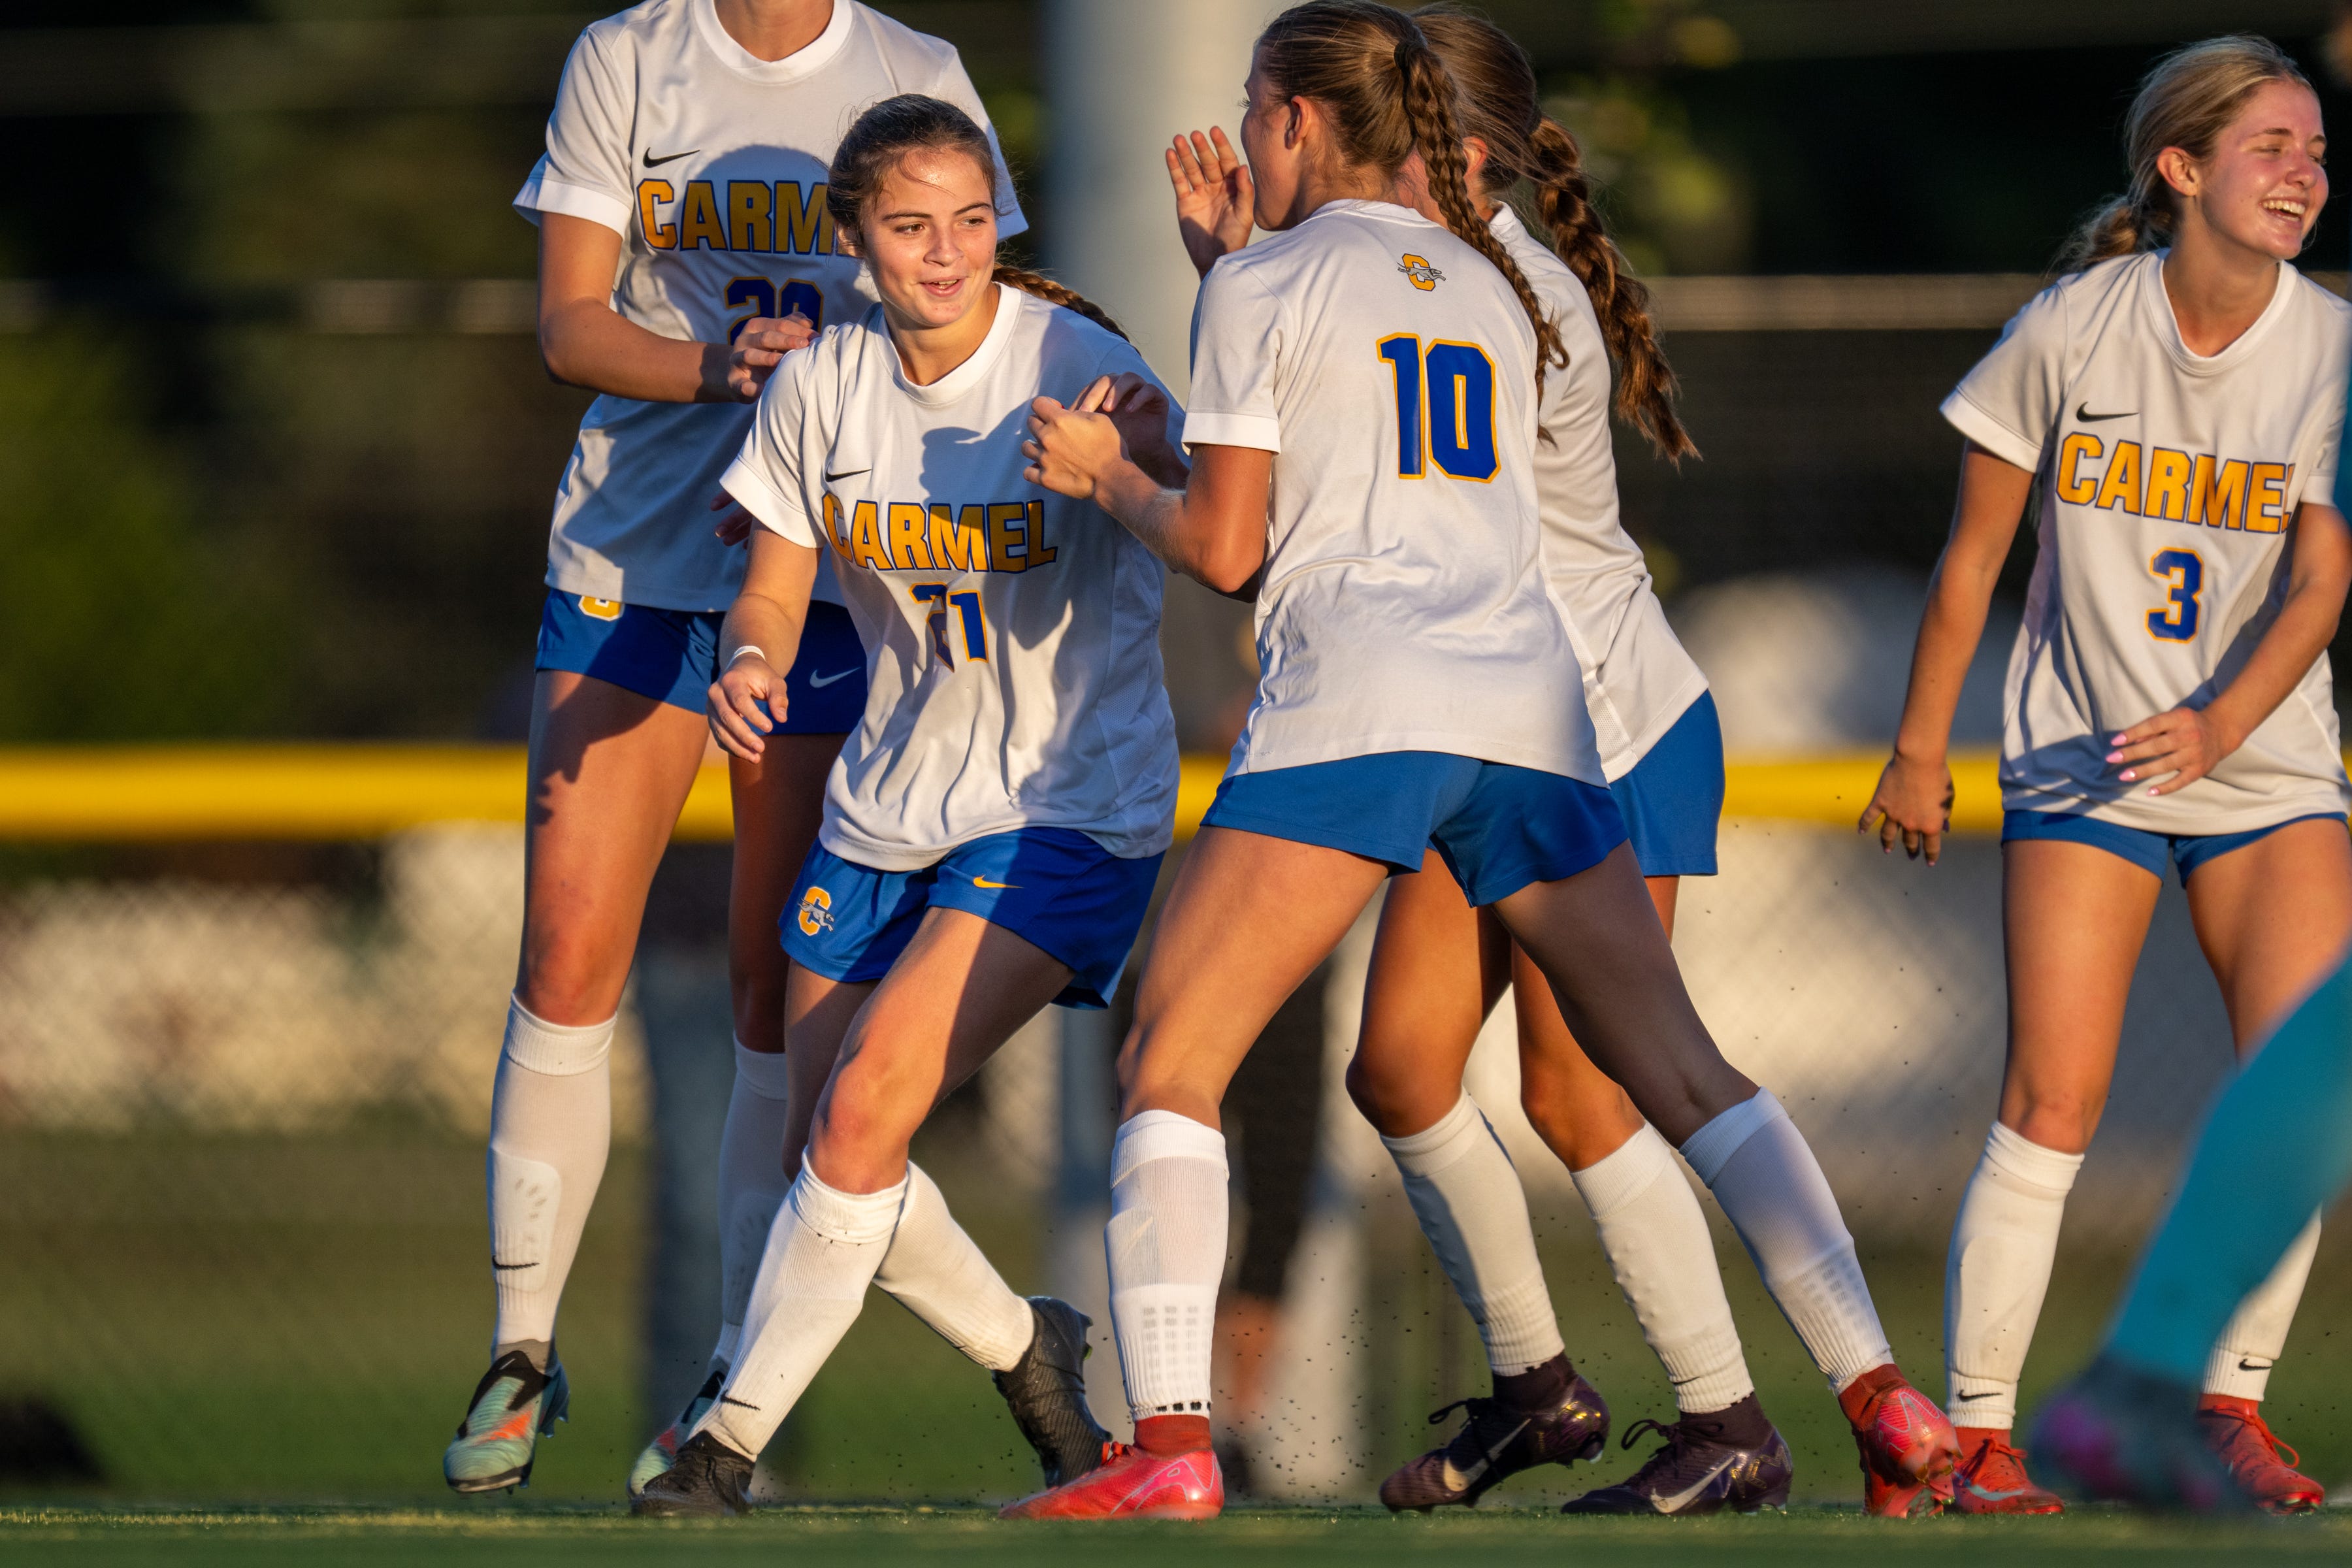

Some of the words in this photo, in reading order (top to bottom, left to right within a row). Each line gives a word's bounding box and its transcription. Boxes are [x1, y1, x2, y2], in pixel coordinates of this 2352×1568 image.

[636, 178, 863, 259] CARM
[1375, 332, 1501, 483] 10
[821, 490, 1058, 574] CARMEL
[908, 581, 989, 673] 21
[2145, 546, 2204, 644] 3
